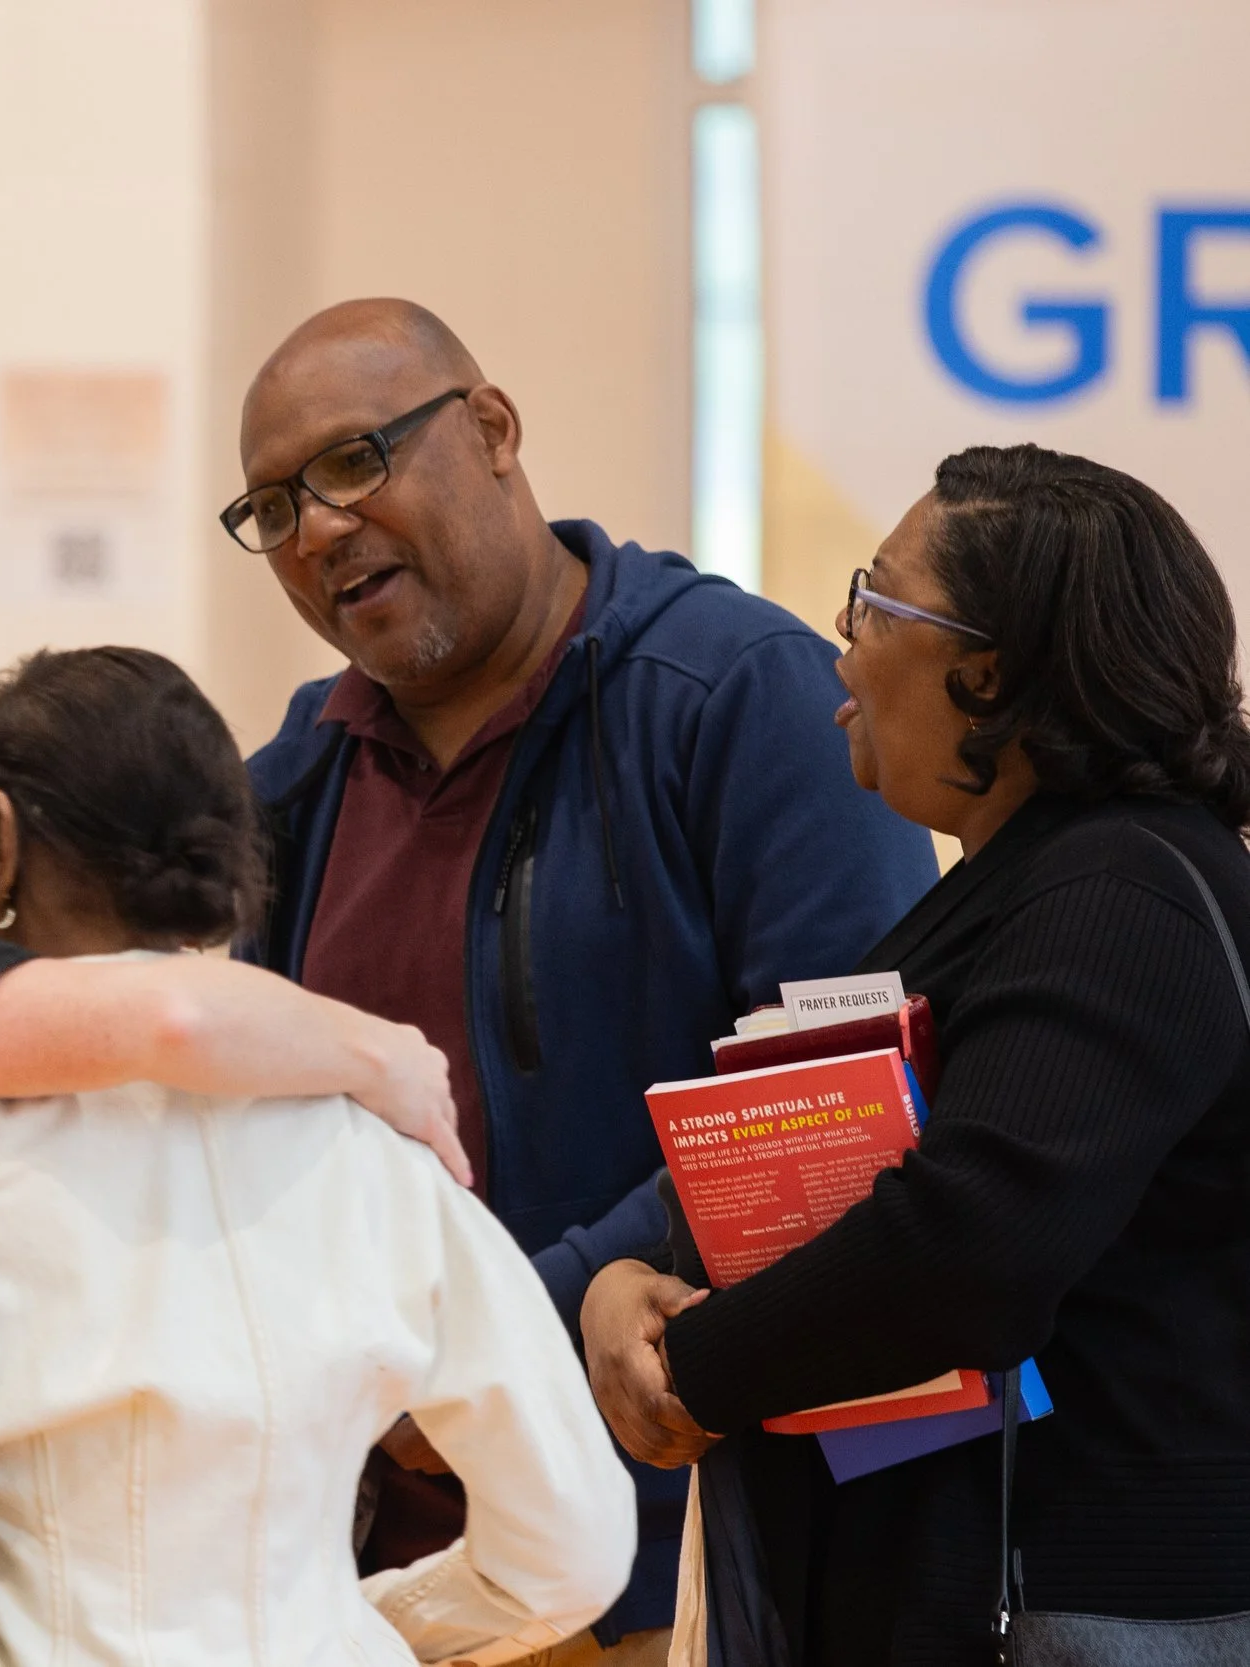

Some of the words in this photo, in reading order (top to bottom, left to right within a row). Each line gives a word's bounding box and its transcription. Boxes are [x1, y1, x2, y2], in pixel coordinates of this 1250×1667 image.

[920, 204, 1250, 404] GR
[799, 996, 837, 1011] PRAYER
[839, 991, 890, 1008] REQUESTS
[669, 1120, 678, 1132] A
[681, 1111, 737, 1131] STRONG
[741, 1097, 814, 1121] SPIRITUAL
[817, 1091, 846, 1107] LIFE
[673, 1130, 729, 1149] IMPACTS
[732, 1121, 774, 1140] EVERY
[780, 1111, 829, 1131] ASPECT
[834, 1108, 853, 1122] OF
[857, 1102, 885, 1119] LIFE
[902, 1093, 920, 1137] BUILD
[679, 1153, 696, 1163] BUILD
[697, 1150, 716, 1160] YOUR
[717, 1147, 730, 1158] LIFE
[732, 1146, 740, 1155] IS
[741, 1146, 748, 1154] A
[749, 1140, 783, 1152] TOOLBOX
[784, 1134, 803, 1145] WITH
[805, 1132, 822, 1142] JUST
[823, 1128, 845, 1139] WHAT
[846, 1126, 862, 1135] YOU
[681, 1162, 698, 1172] NEED
[699, 1161, 709, 1169] TO
[710, 1155, 746, 1168] ESTABLISH
[754, 1150, 784, 1161] STRONG
[786, 1144, 822, 1156] SPIRITUAL
